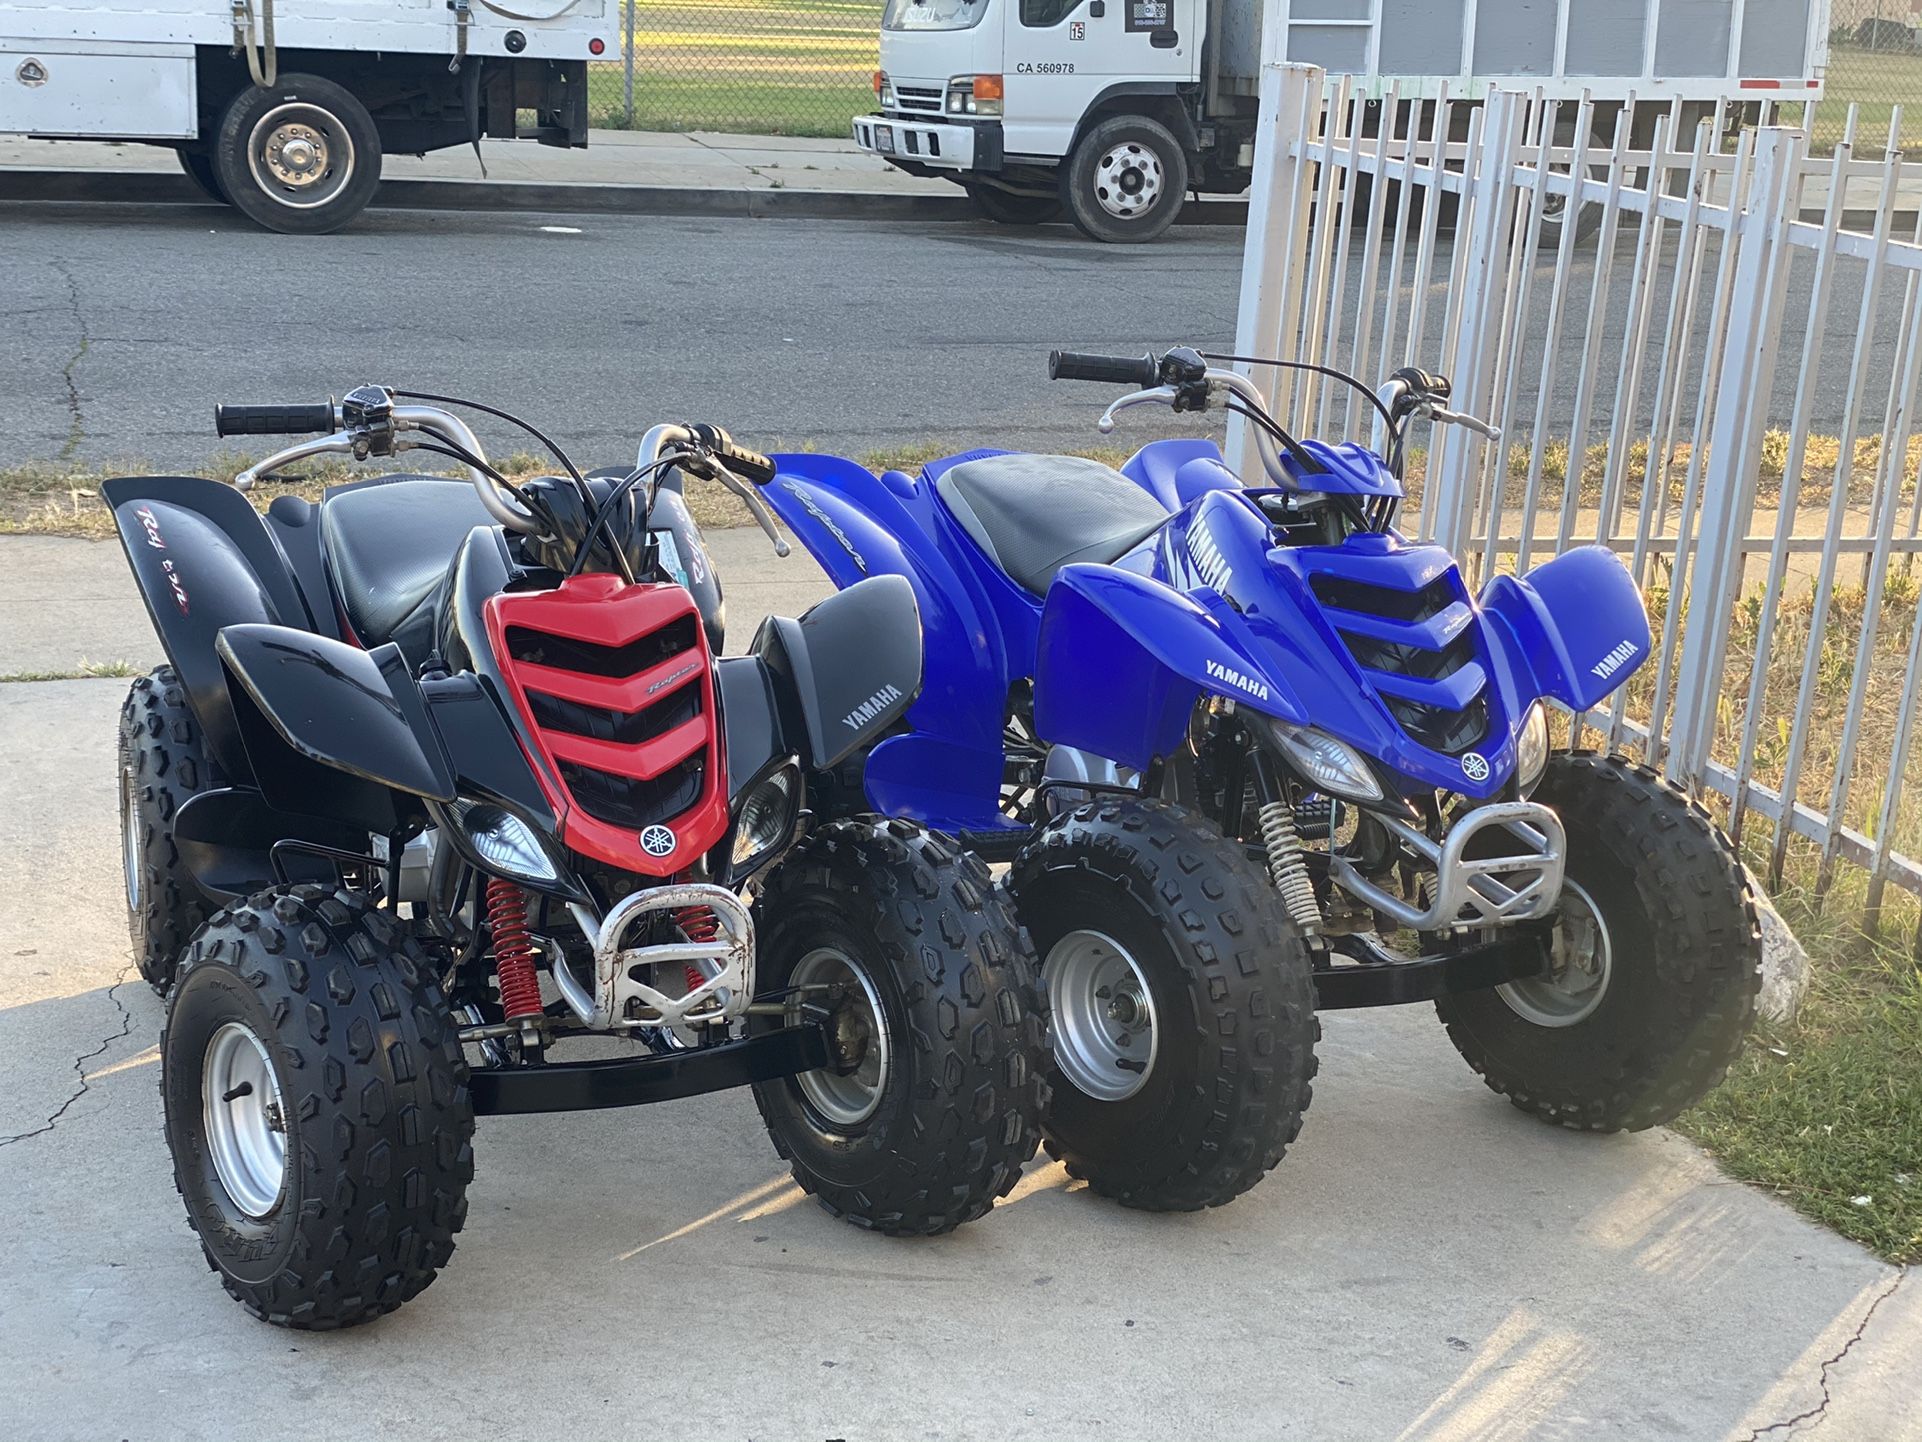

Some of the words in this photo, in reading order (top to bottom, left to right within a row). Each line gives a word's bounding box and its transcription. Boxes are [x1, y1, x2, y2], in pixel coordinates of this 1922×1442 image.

[1072, 27, 1083, 39] 15
[1016, 63, 1033, 73] CA
[1036, 63, 1075, 74] 560978
[783, 482, 865, 572] Raptor
[1186, 509, 1233, 597] YAMAHA
[1205, 659, 1269, 701] YAMAHA
[1591, 639, 1639, 680] YAMAHA
[842, 683, 903, 731] YAMAHA
